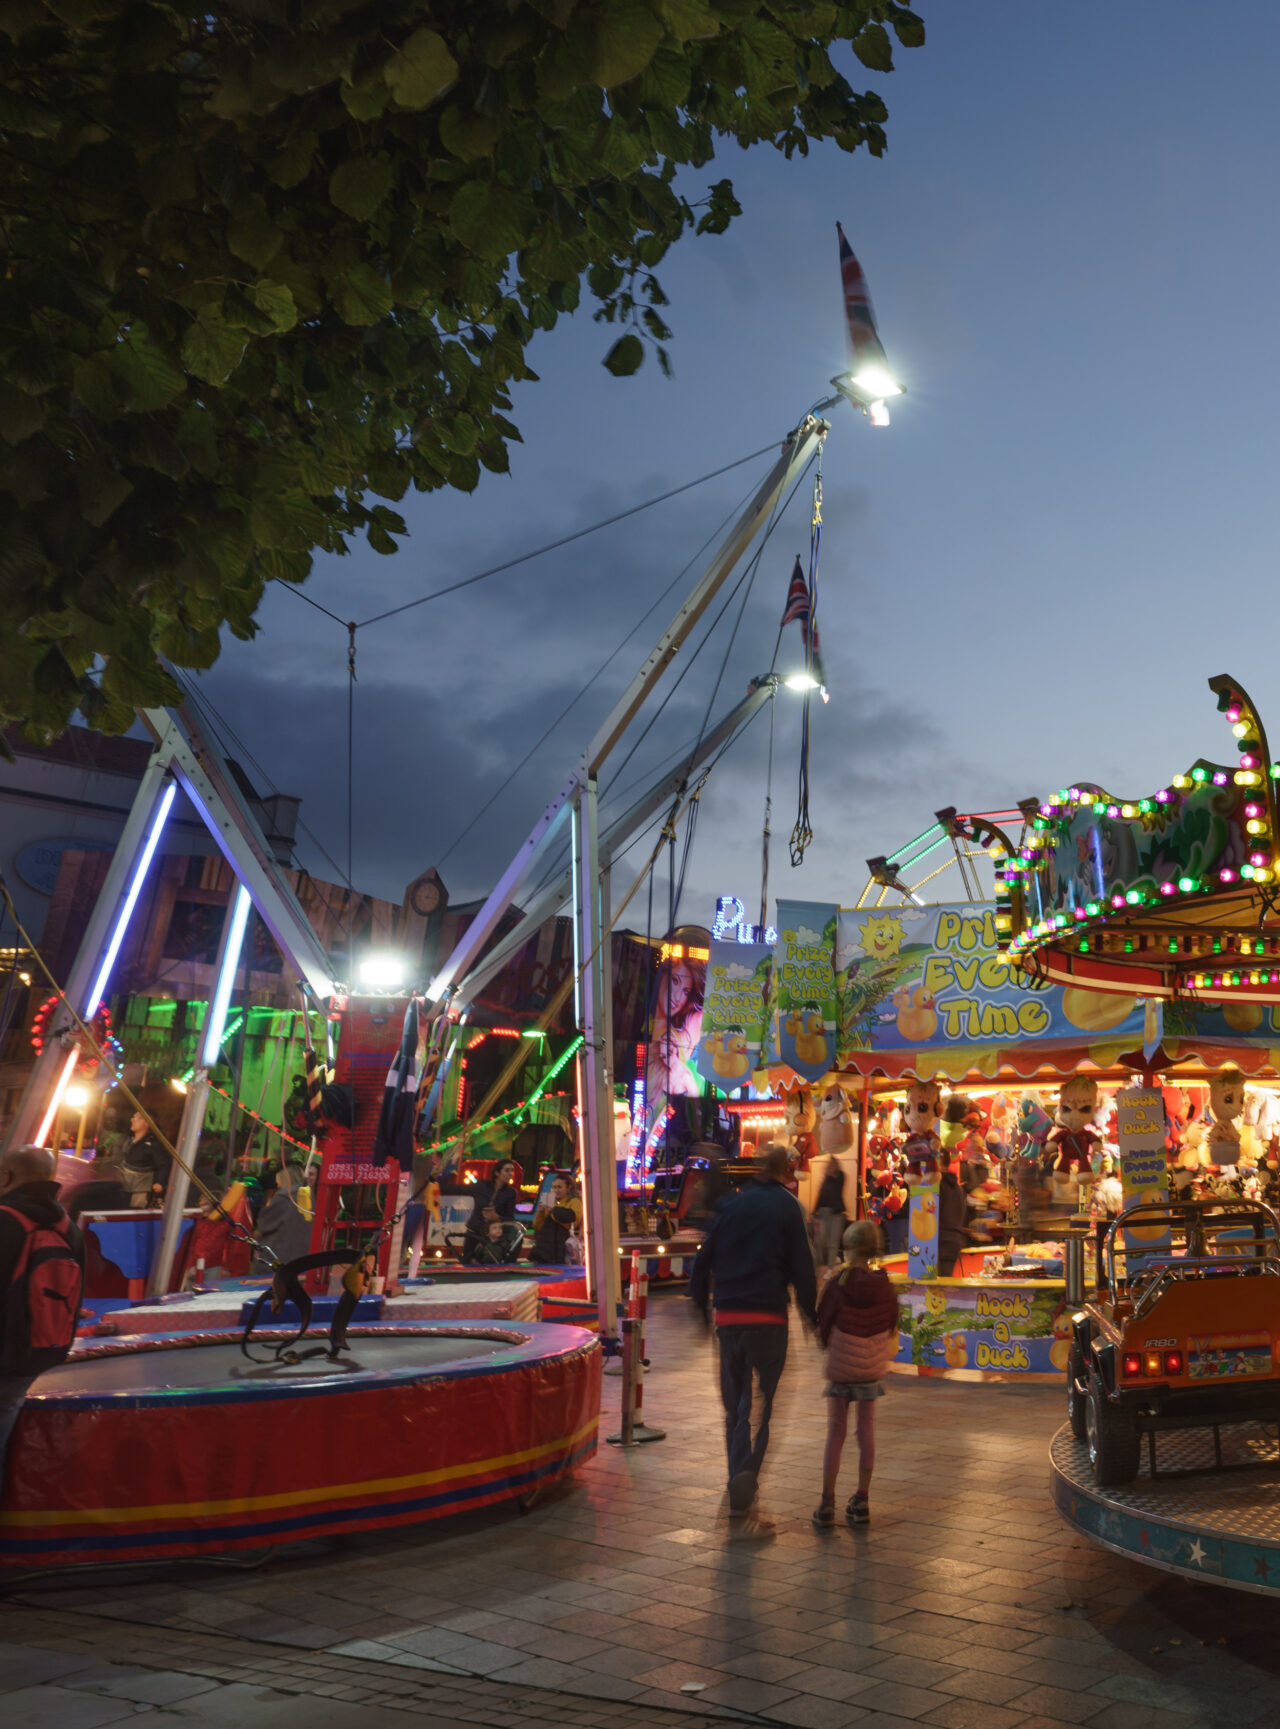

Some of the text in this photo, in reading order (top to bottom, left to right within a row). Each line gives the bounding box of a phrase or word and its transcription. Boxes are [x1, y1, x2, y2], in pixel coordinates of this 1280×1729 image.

[936, 910, 1003, 950] Pri
[787, 943, 830, 962] Prize
[783, 963, 833, 983] Every
[714, 977, 761, 992] Prize
[709, 993, 763, 1010] Every
[939, 999, 1048, 1036] Time
[1122, 1095, 1159, 1109] Hook
[1135, 1109, 1146, 1121] a
[1123, 1121, 1160, 1135] Duck
[976, 1294, 1030, 1318] Hook
[994, 1321, 1011, 1344] a
[976, 1342, 1029, 1368] Duck
